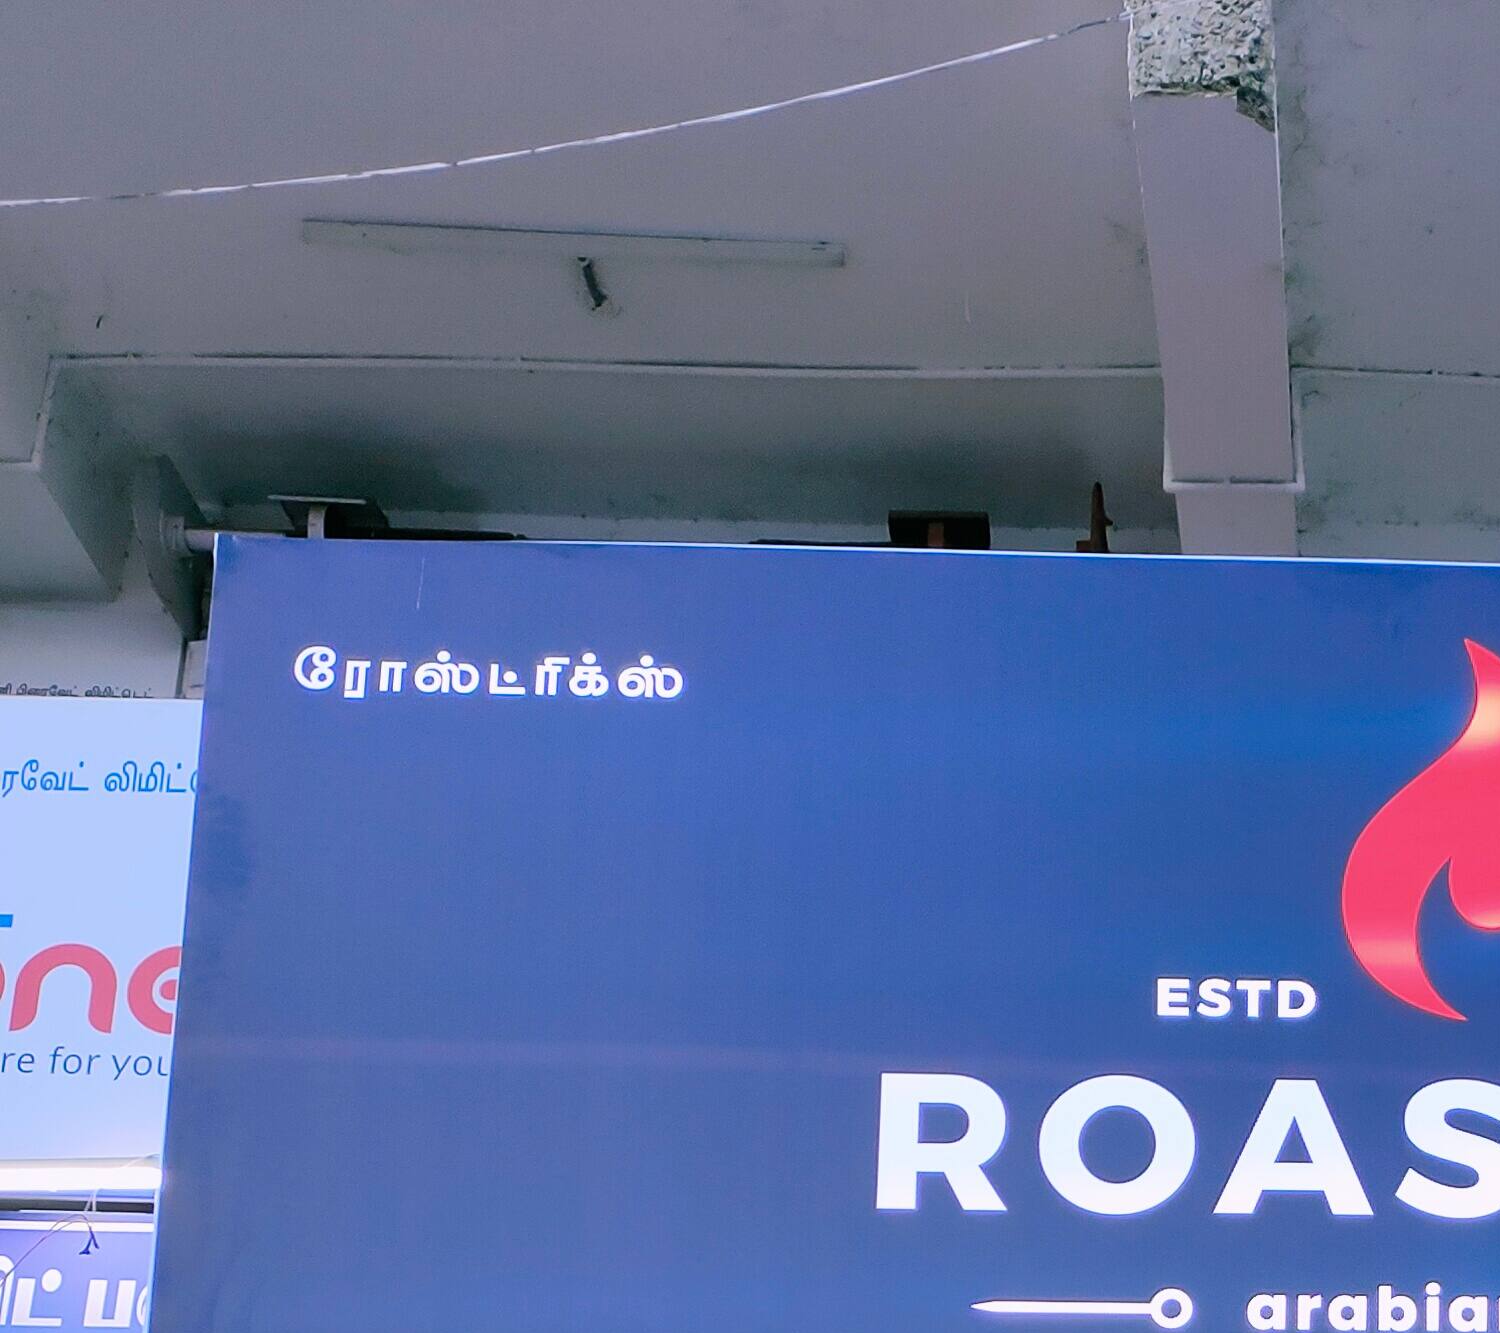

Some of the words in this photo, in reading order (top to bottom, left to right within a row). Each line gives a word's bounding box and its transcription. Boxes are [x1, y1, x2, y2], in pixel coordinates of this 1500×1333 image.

[293, 646, 684, 699] ரோஸ்ட்ரிக்ஸ்
[1155, 977, 1318, 1019] ESTD
[49, 1046, 101, 1075] for
